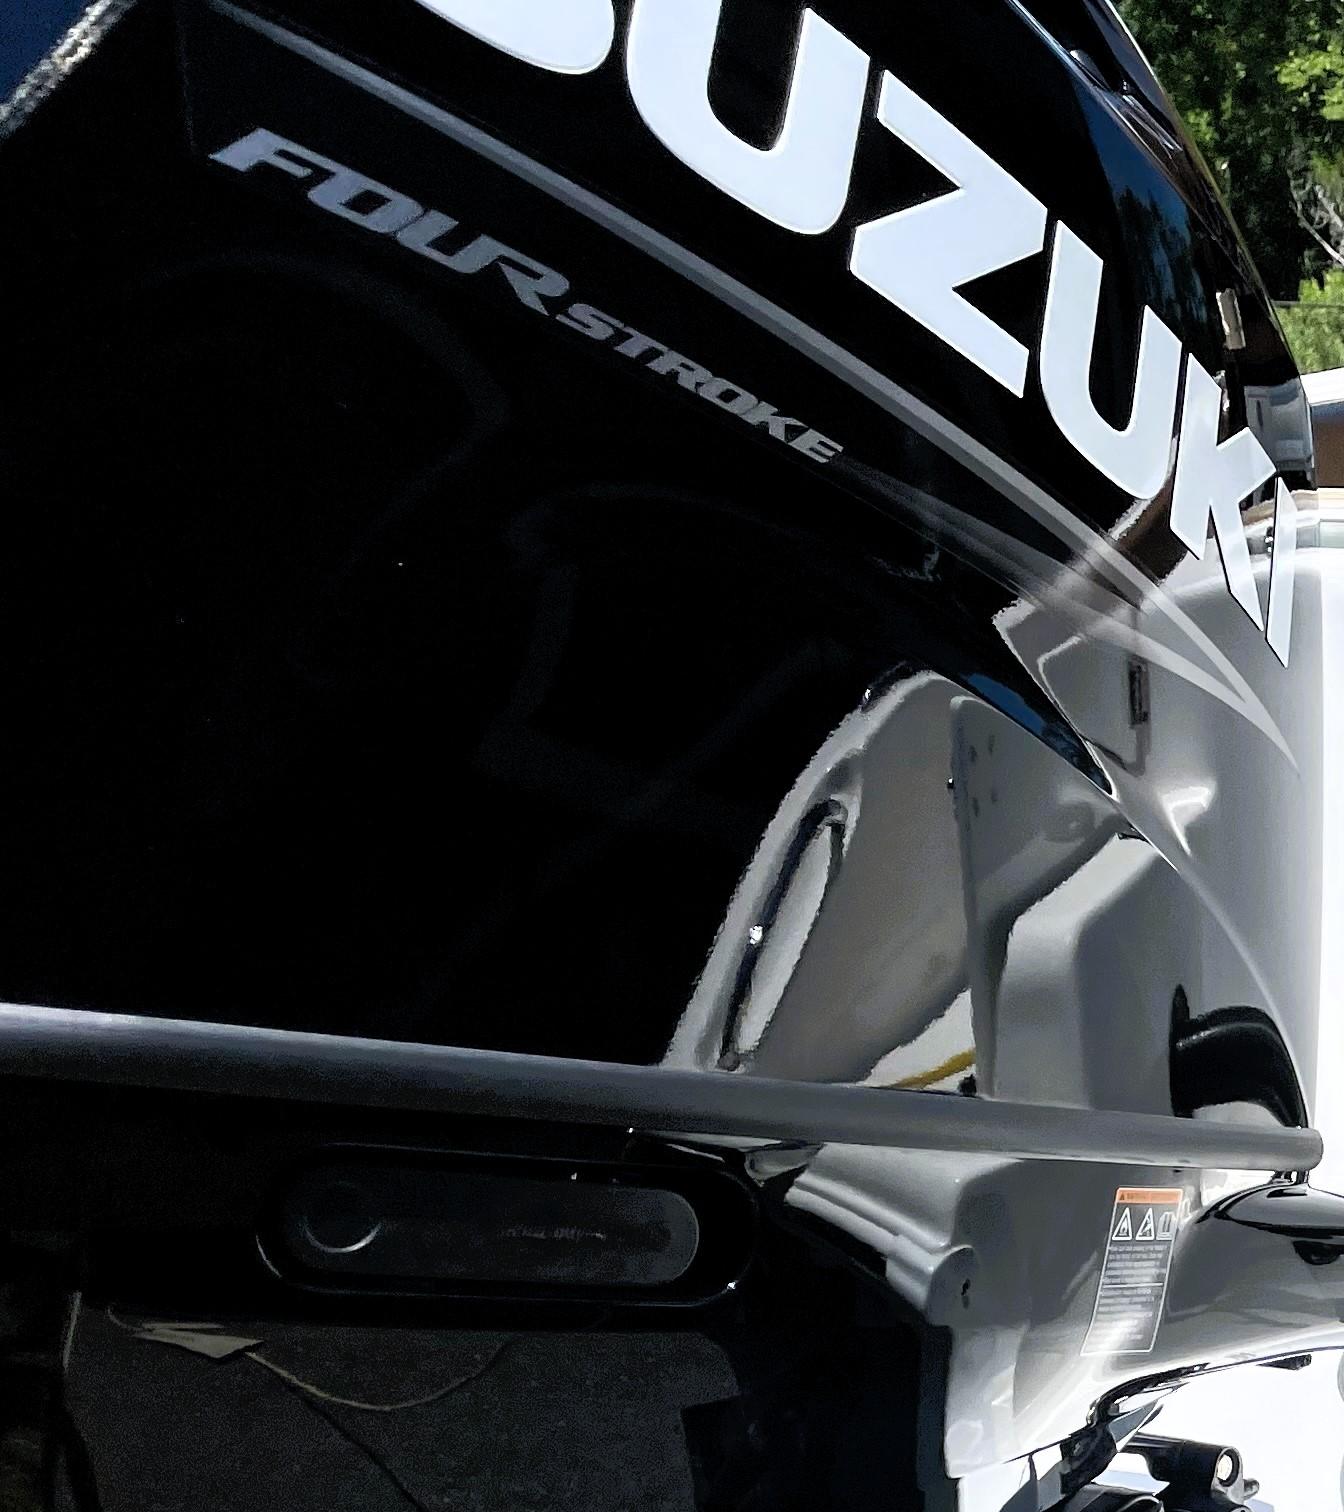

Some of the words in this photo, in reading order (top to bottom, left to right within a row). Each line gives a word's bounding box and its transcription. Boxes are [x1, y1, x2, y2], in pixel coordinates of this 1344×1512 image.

[208, 126, 571, 317] FOUR
[556, 301, 844, 465] STROKE
[418, 0, 1298, 668] UZUKI
